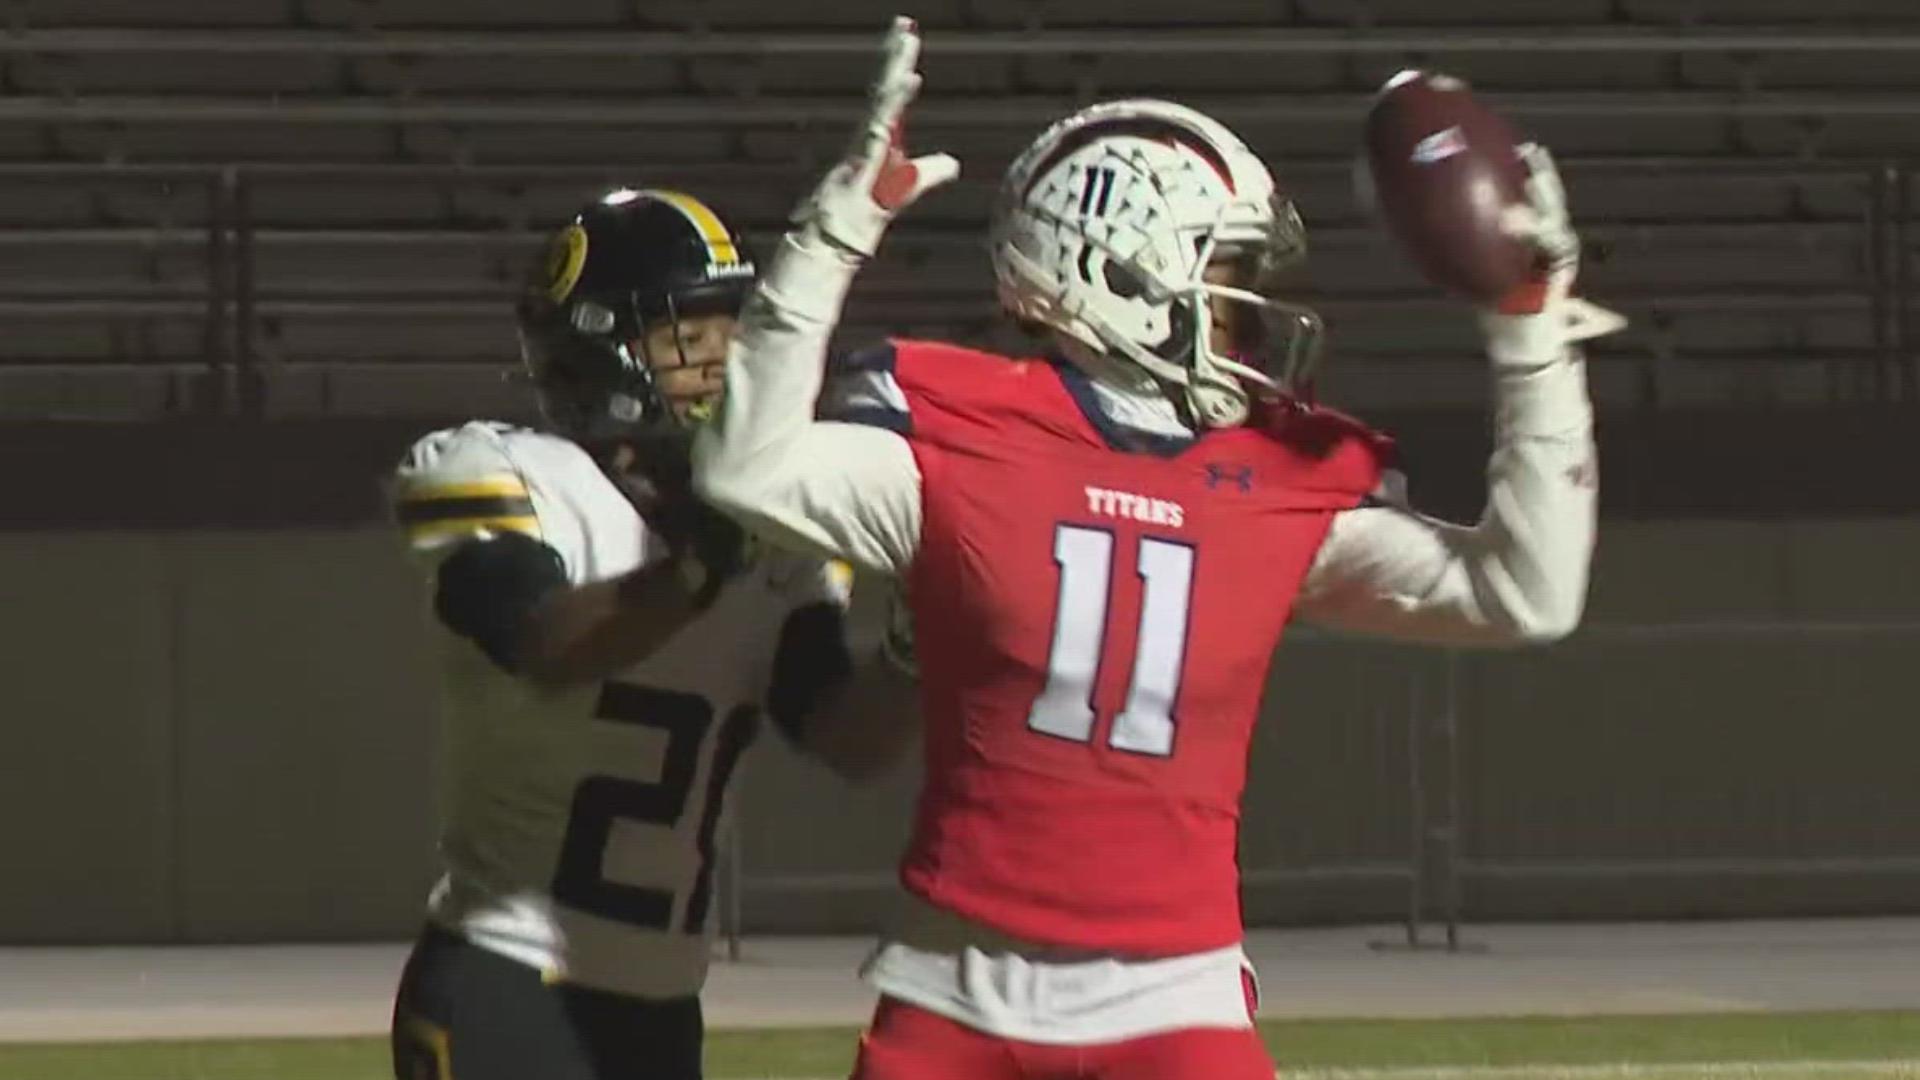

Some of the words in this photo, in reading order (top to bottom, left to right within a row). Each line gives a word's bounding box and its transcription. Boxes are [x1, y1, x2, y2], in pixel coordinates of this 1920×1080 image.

[1079, 165, 1116, 217] 11
[1085, 486, 1184, 528] TITANS
[1027, 521, 1197, 758] 11
